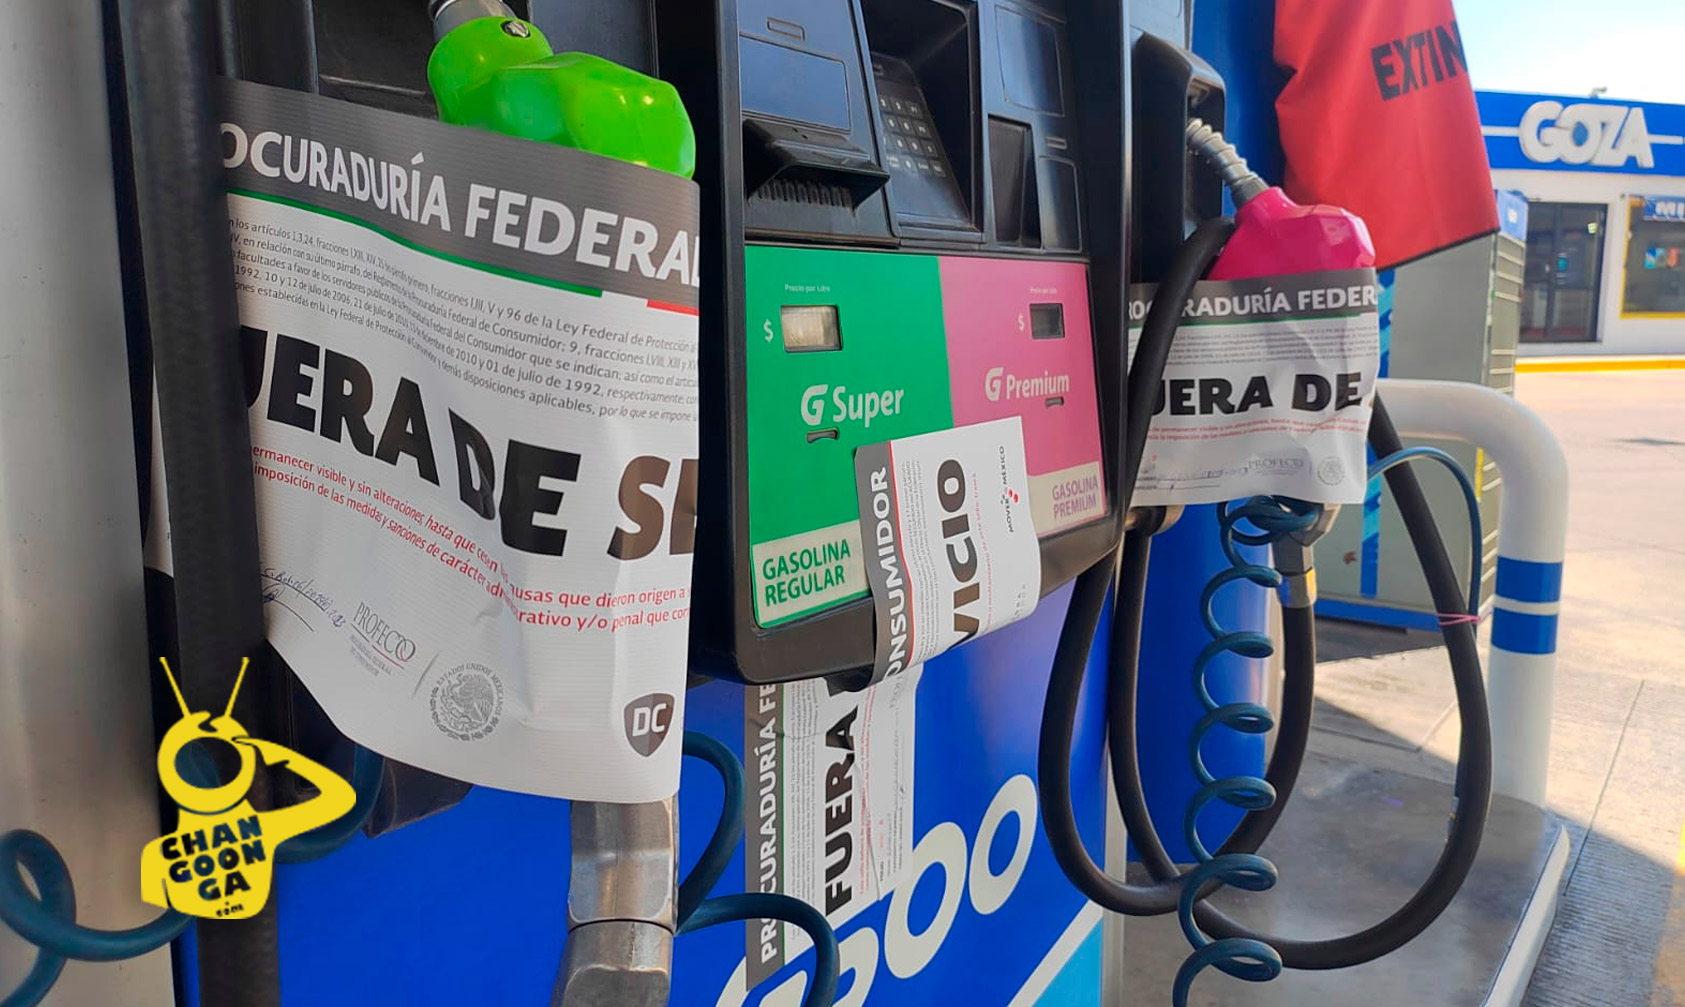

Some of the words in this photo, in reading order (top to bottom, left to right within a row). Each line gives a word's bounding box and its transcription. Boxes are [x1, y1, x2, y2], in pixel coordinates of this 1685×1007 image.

[1370, 20, 1469, 101] EXTIN
[1519, 100, 1654, 168] GOZA
[237, 250, 286, 270] facultades
[466, 334, 527, 360] Consumidor
[529, 354, 552, 368] que
[556, 360, 570, 371] se
[243, 238, 255, 247] en
[257, 240, 292, 256] relación
[478, 320, 490, 332] de
[585, 344, 644, 365] fracciones
[251, 222, 291, 240] artículos
[506, 308, 521, 321] 96
[524, 312, 540, 326] de
[542, 316, 552, 329] la
[556, 318, 580, 336] Ley
[582, 324, 628, 343] Federal
[630, 333, 644, 346] de
[1298, 284, 1378, 311] FEDER
[257, 286, 309, 308] establecidas
[326, 304, 338, 319] Ley
[340, 309, 364, 326] Federal
[463, 370, 526, 400] disposiciones
[598, 405, 618, 418] por
[619, 405, 628, 416] lo
[630, 408, 647, 420] que
[648, 410, 659, 420] se
[266, 272, 278, 283] 10
[279, 276, 286, 286] y
[288, 276, 298, 288] 12
[456, 348, 478, 366] 2010
[479, 359, 484, 370] y
[486, 359, 498, 372] 01
[501, 364, 516, 378] de
[517, 367, 543, 384] julio
[545, 374, 561, 388] de
[762, 319, 774, 343] $
[1018, 312, 1024, 333] $
[801, 384, 829, 426] G
[832, 386, 905, 428] Super
[984, 366, 1004, 402] G
[1006, 370, 1070, 400] Premium
[1291, 372, 1362, 412] DE
[448, 407, 581, 557] DE
[1051, 474, 1099, 501] GASOLINA
[1053, 493, 1097, 520] PREMIUM
[251, 446, 314, 472] ermanecer
[317, 464, 346, 486] visible
[349, 478, 356, 492] y
[358, 481, 371, 496] sin
[424, 514, 454, 540] hasta
[454, 534, 477, 554] que
[558, 592, 591, 608] que
[596, 592, 635, 608] dieron
[640, 588, 676, 605] origen
[679, 589, 685, 598] a
[254, 462, 315, 492] imposición
[318, 483, 329, 497] de
[331, 488, 344, 504] las
[346, 498, 382, 522] medidas
[380, 516, 388, 528] y
[388, 520, 426, 550] sanciones
[426, 542, 440, 558] de
[440, 552, 486, 586] carácter
[577, 614, 608, 632] y/o
[611, 610, 644, 632] penal
[646, 611, 669, 627] que
[762, 538, 851, 580] GASOLINA
[765, 565, 846, 607] REGULAR
[632, 702, 667, 737] DC
[754, 717, 778, 964] PRCURADURÍA
[825, 704, 858, 917] FUERA
